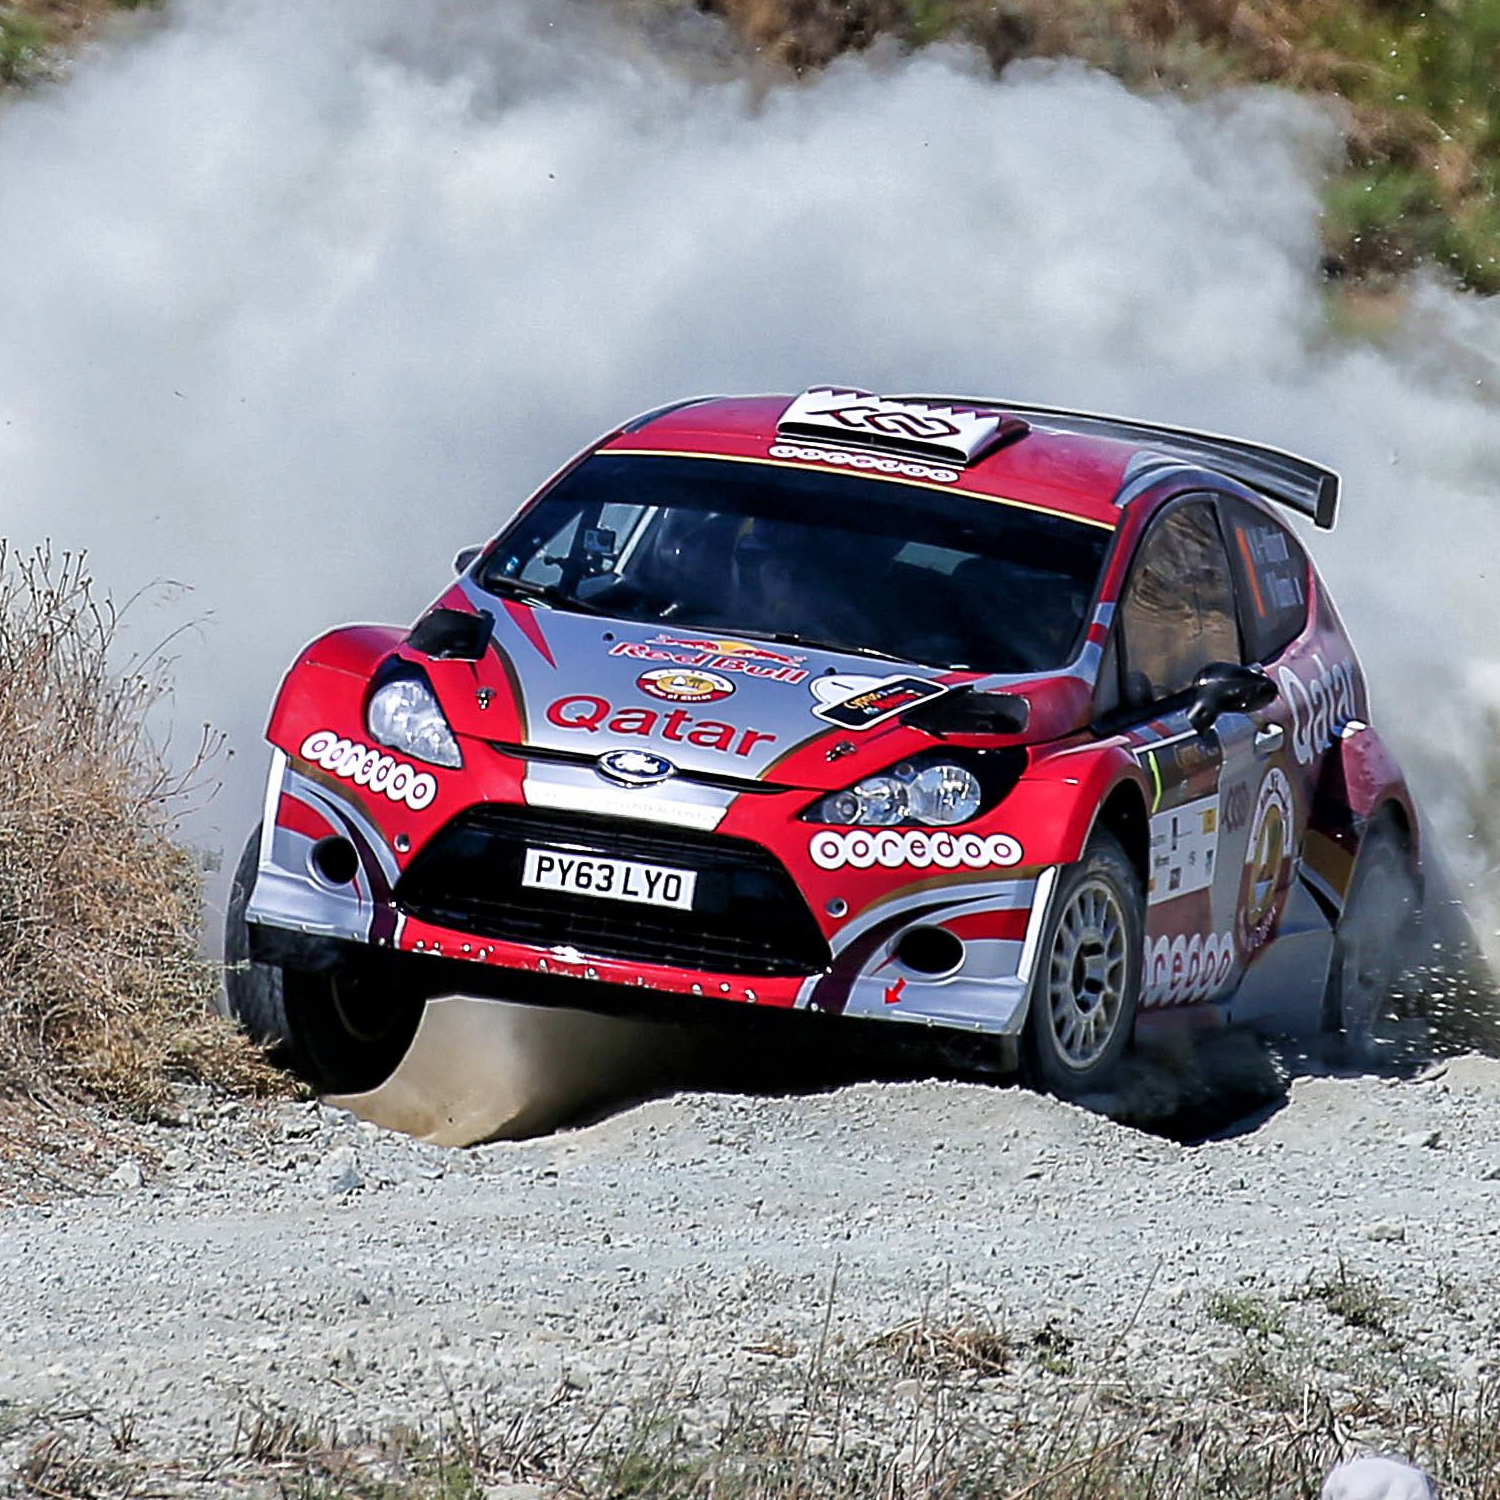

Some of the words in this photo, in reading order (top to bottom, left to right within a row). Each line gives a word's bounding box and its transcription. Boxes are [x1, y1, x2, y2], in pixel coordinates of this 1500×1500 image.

[609, 642, 713, 666] Red
[708, 655, 810, 685] Bull
[546, 694, 777, 758] Qatar
[304, 734, 433, 806] ooredoo
[813, 833, 1019, 866] ooredoo
[536, 855, 615, 892] PY63
[622, 866, 682, 902] LYO
